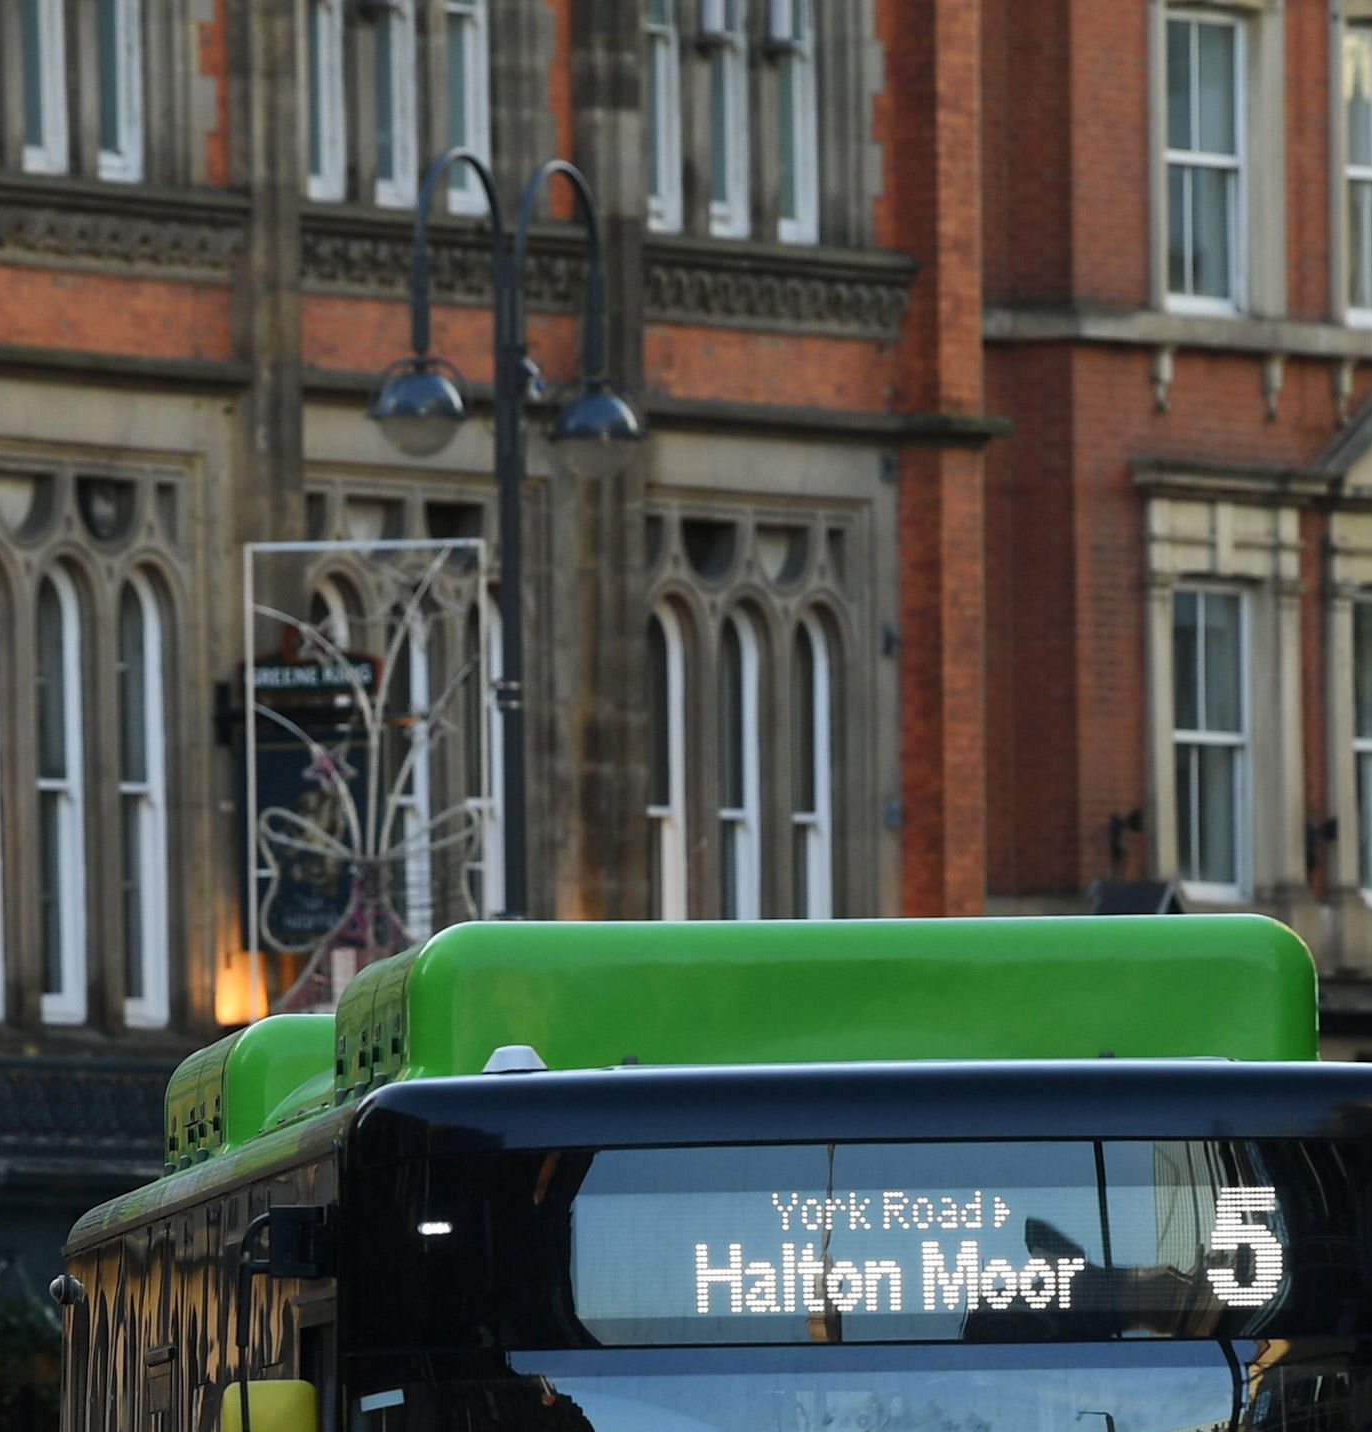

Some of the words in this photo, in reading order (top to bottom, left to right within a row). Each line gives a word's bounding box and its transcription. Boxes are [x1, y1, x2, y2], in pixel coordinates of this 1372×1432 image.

[771, 1191, 872, 1230] York
[882, 1190, 983, 1229] Road
[695, 1241, 901, 1313] Halton
[922, 1240, 1085, 1311] Moor
[1207, 1186, 1285, 1308] 5
